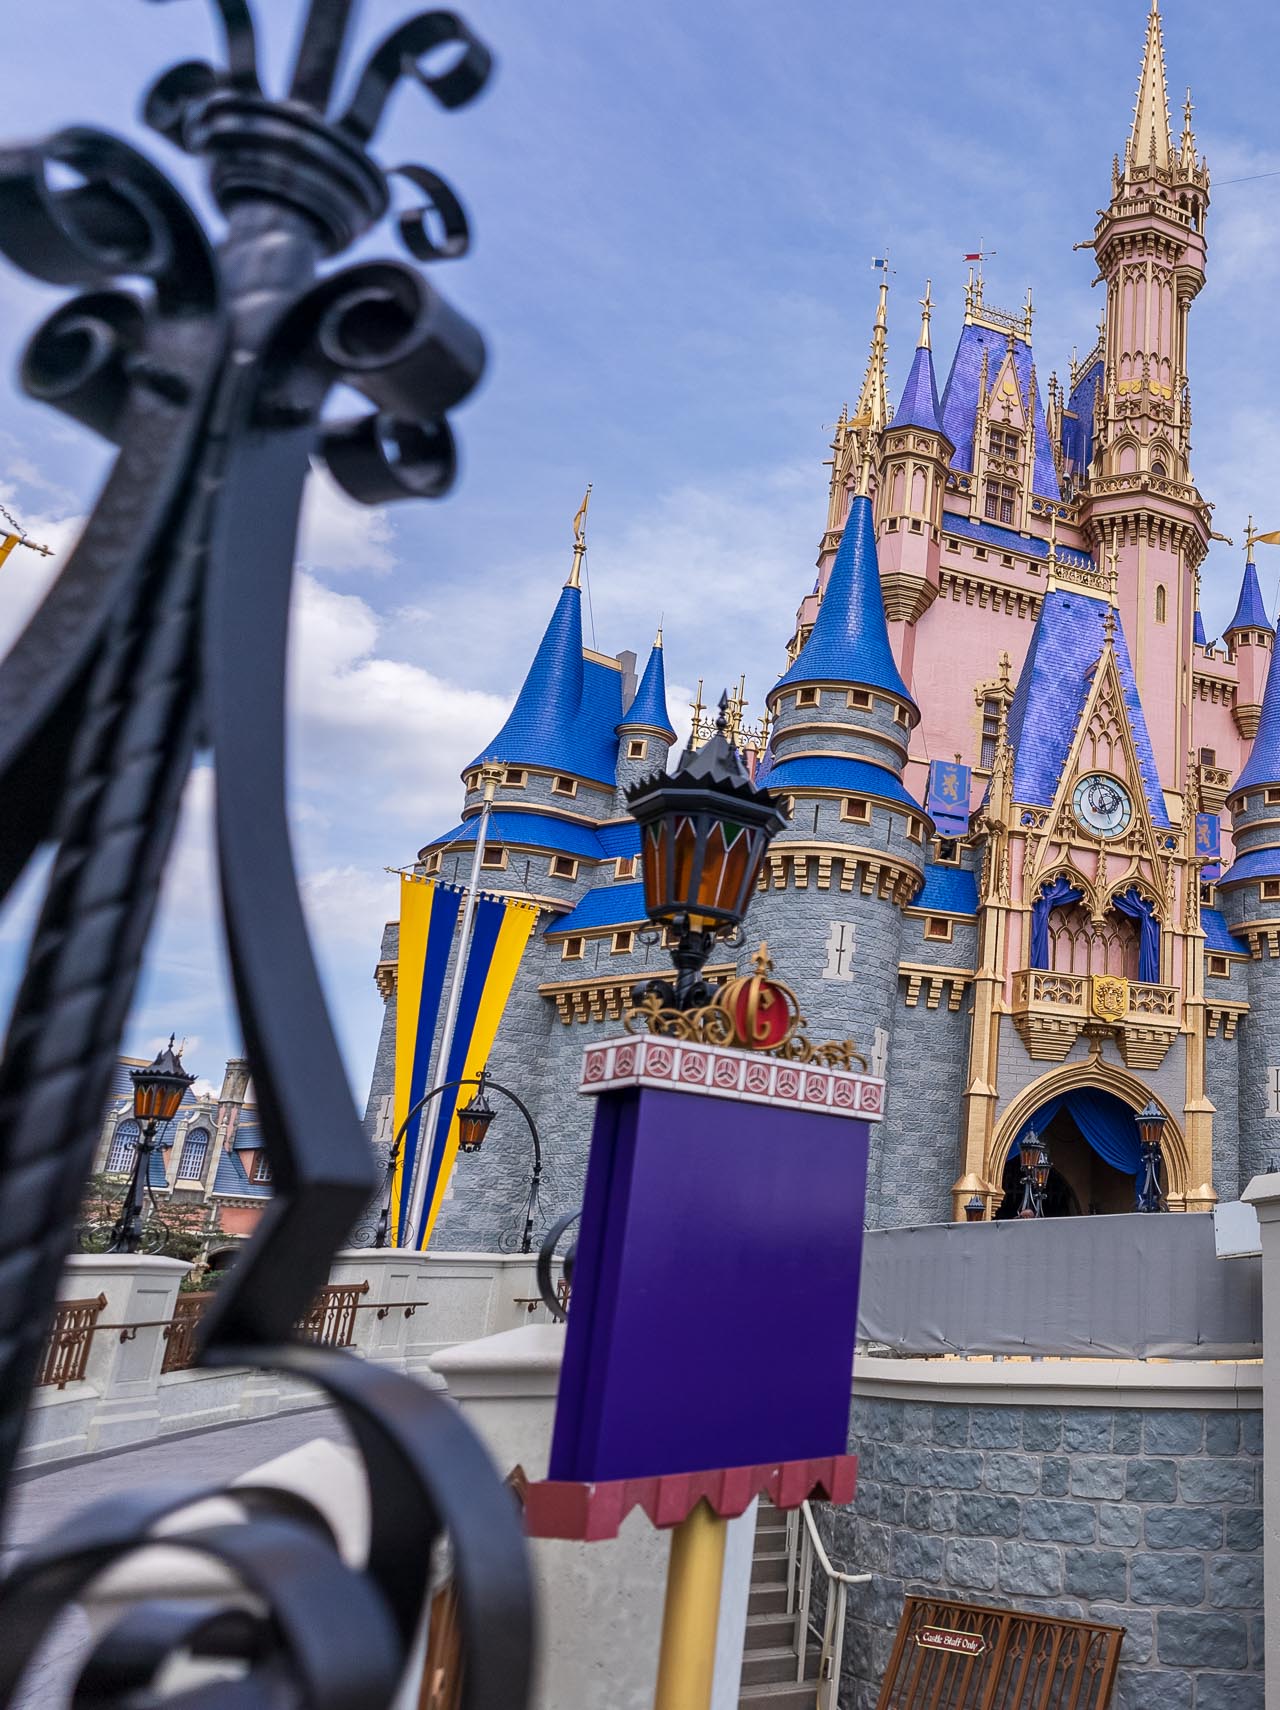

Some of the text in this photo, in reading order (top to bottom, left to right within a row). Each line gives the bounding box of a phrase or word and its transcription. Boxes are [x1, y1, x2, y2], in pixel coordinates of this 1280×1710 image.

[922, 1632, 978, 1651] Castle Staff Only
